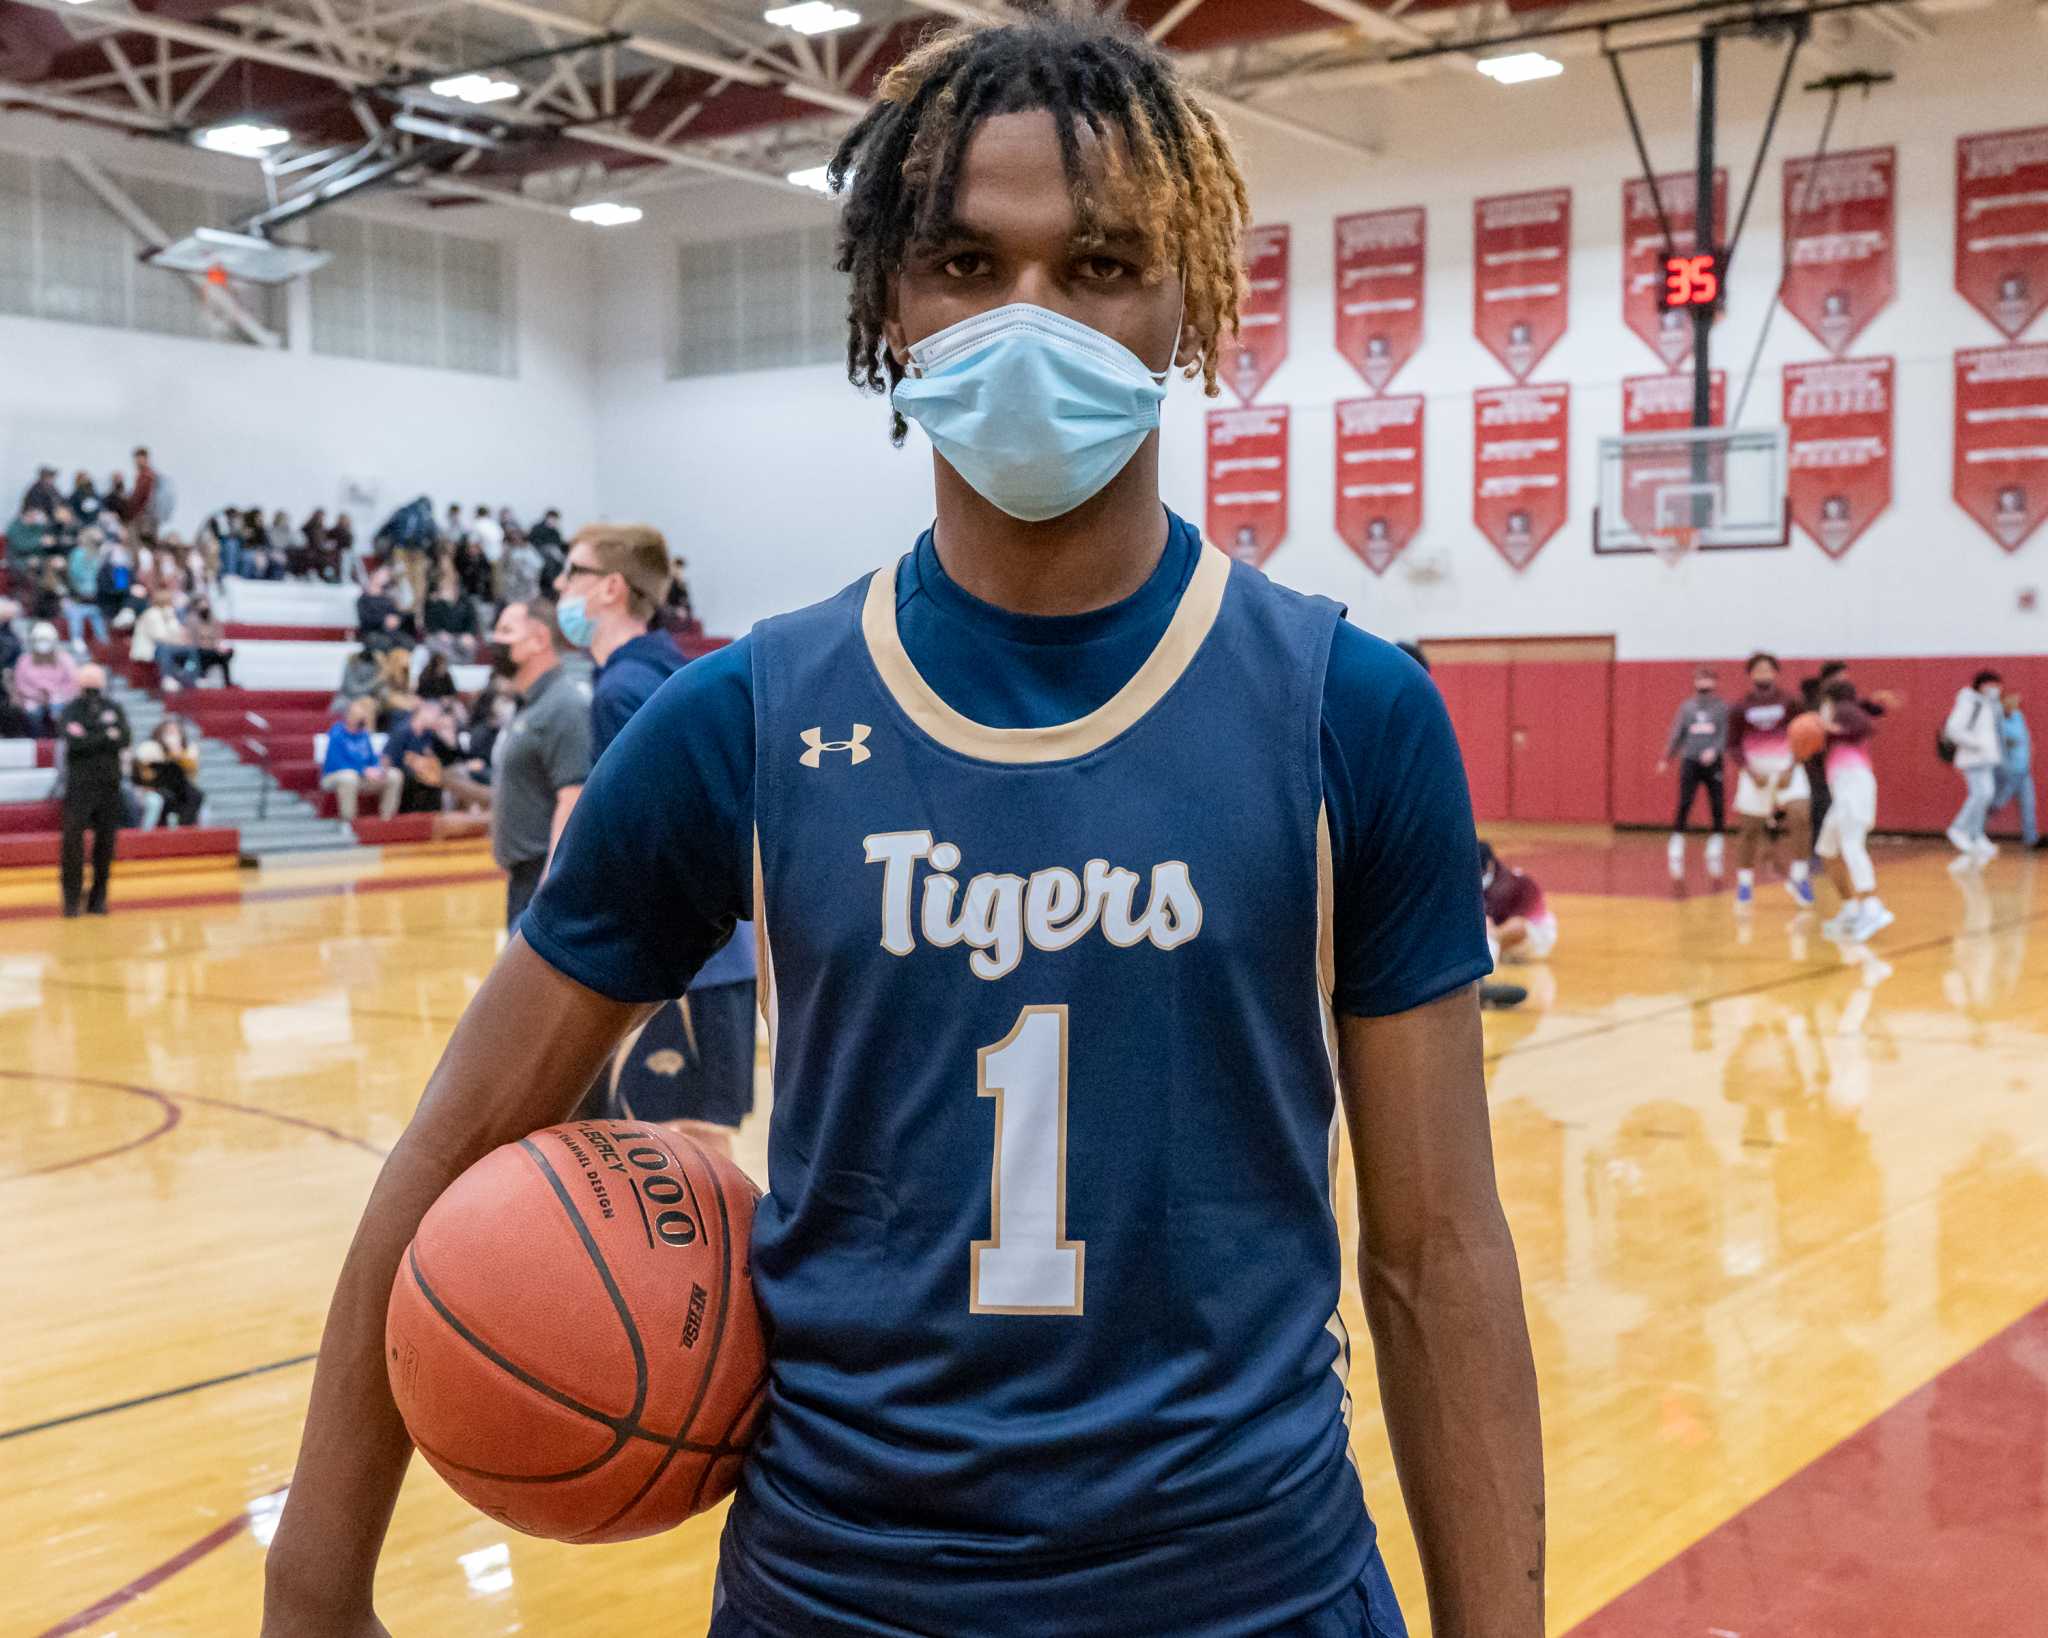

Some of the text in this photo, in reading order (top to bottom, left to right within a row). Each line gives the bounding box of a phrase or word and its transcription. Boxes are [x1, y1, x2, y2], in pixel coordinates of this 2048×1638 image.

[1667, 256, 1716, 304] 35
[863, 830, 1203, 981] Tigers
[559, 1134, 615, 1219] CHANNEL DESIGN
[581, 1128, 627, 1173] LEGACY
[969, 1004, 1085, 1315] 1
